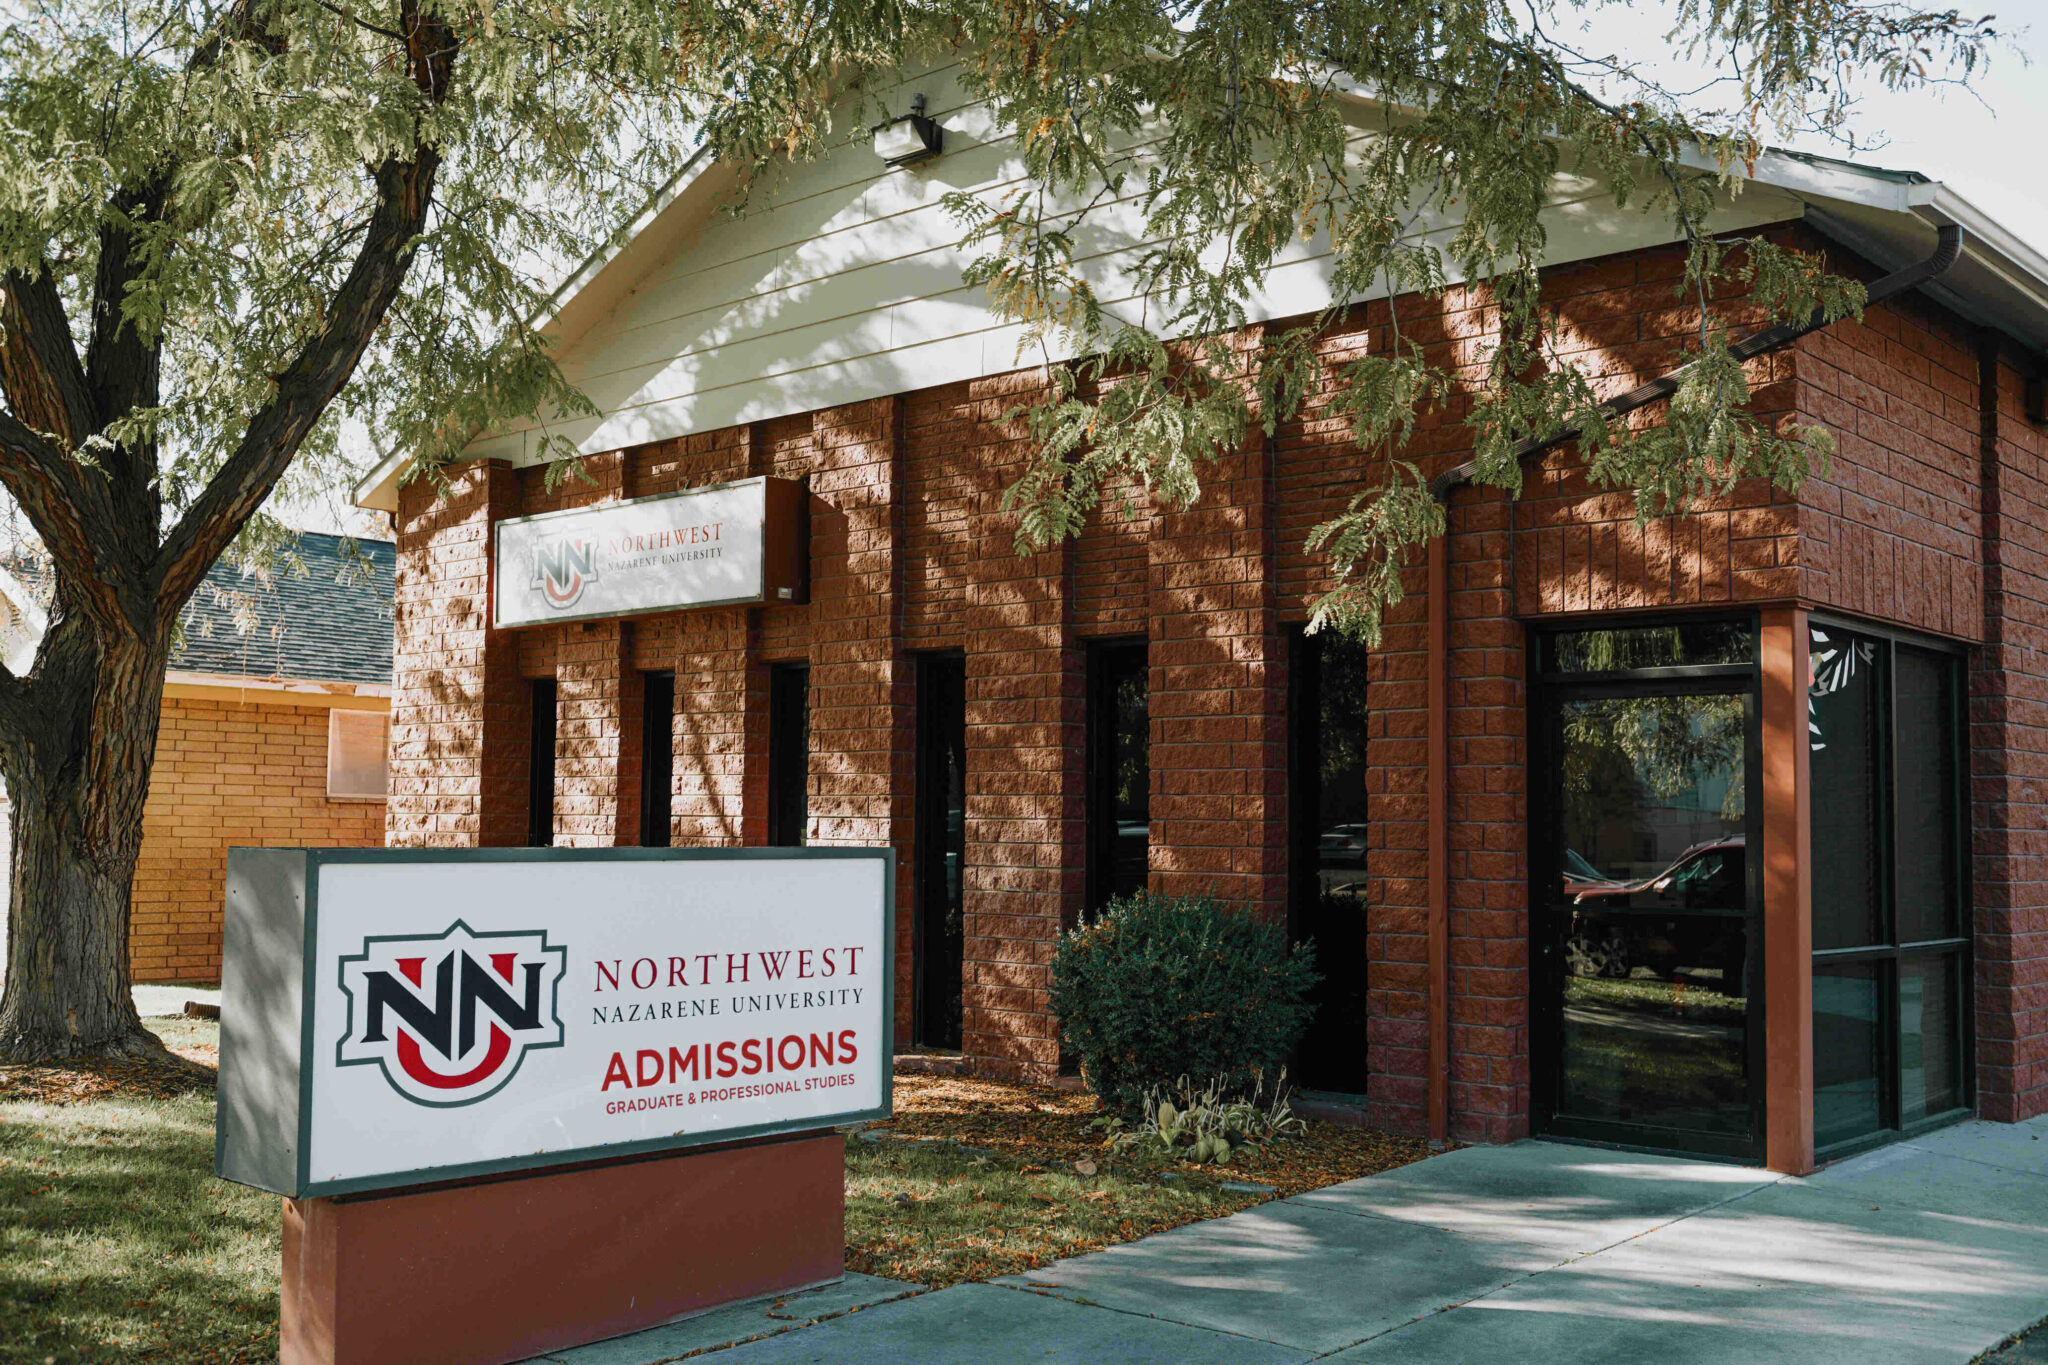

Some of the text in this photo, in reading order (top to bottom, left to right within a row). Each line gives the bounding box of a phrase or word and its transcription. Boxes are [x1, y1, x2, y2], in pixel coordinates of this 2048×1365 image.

[608, 522, 723, 555] NORTHWEST
[608, 547, 723, 572] NAZARENE UNIVERSITY
[594, 946, 864, 992] NORTHWEST
[592, 988, 864, 1025] NAZARENE UNIVERSITY
[601, 1029, 858, 1092] ADMISSIONS
[606, 1073, 855, 1115] GRADUATE & PROFESSIONAL STUDIES
